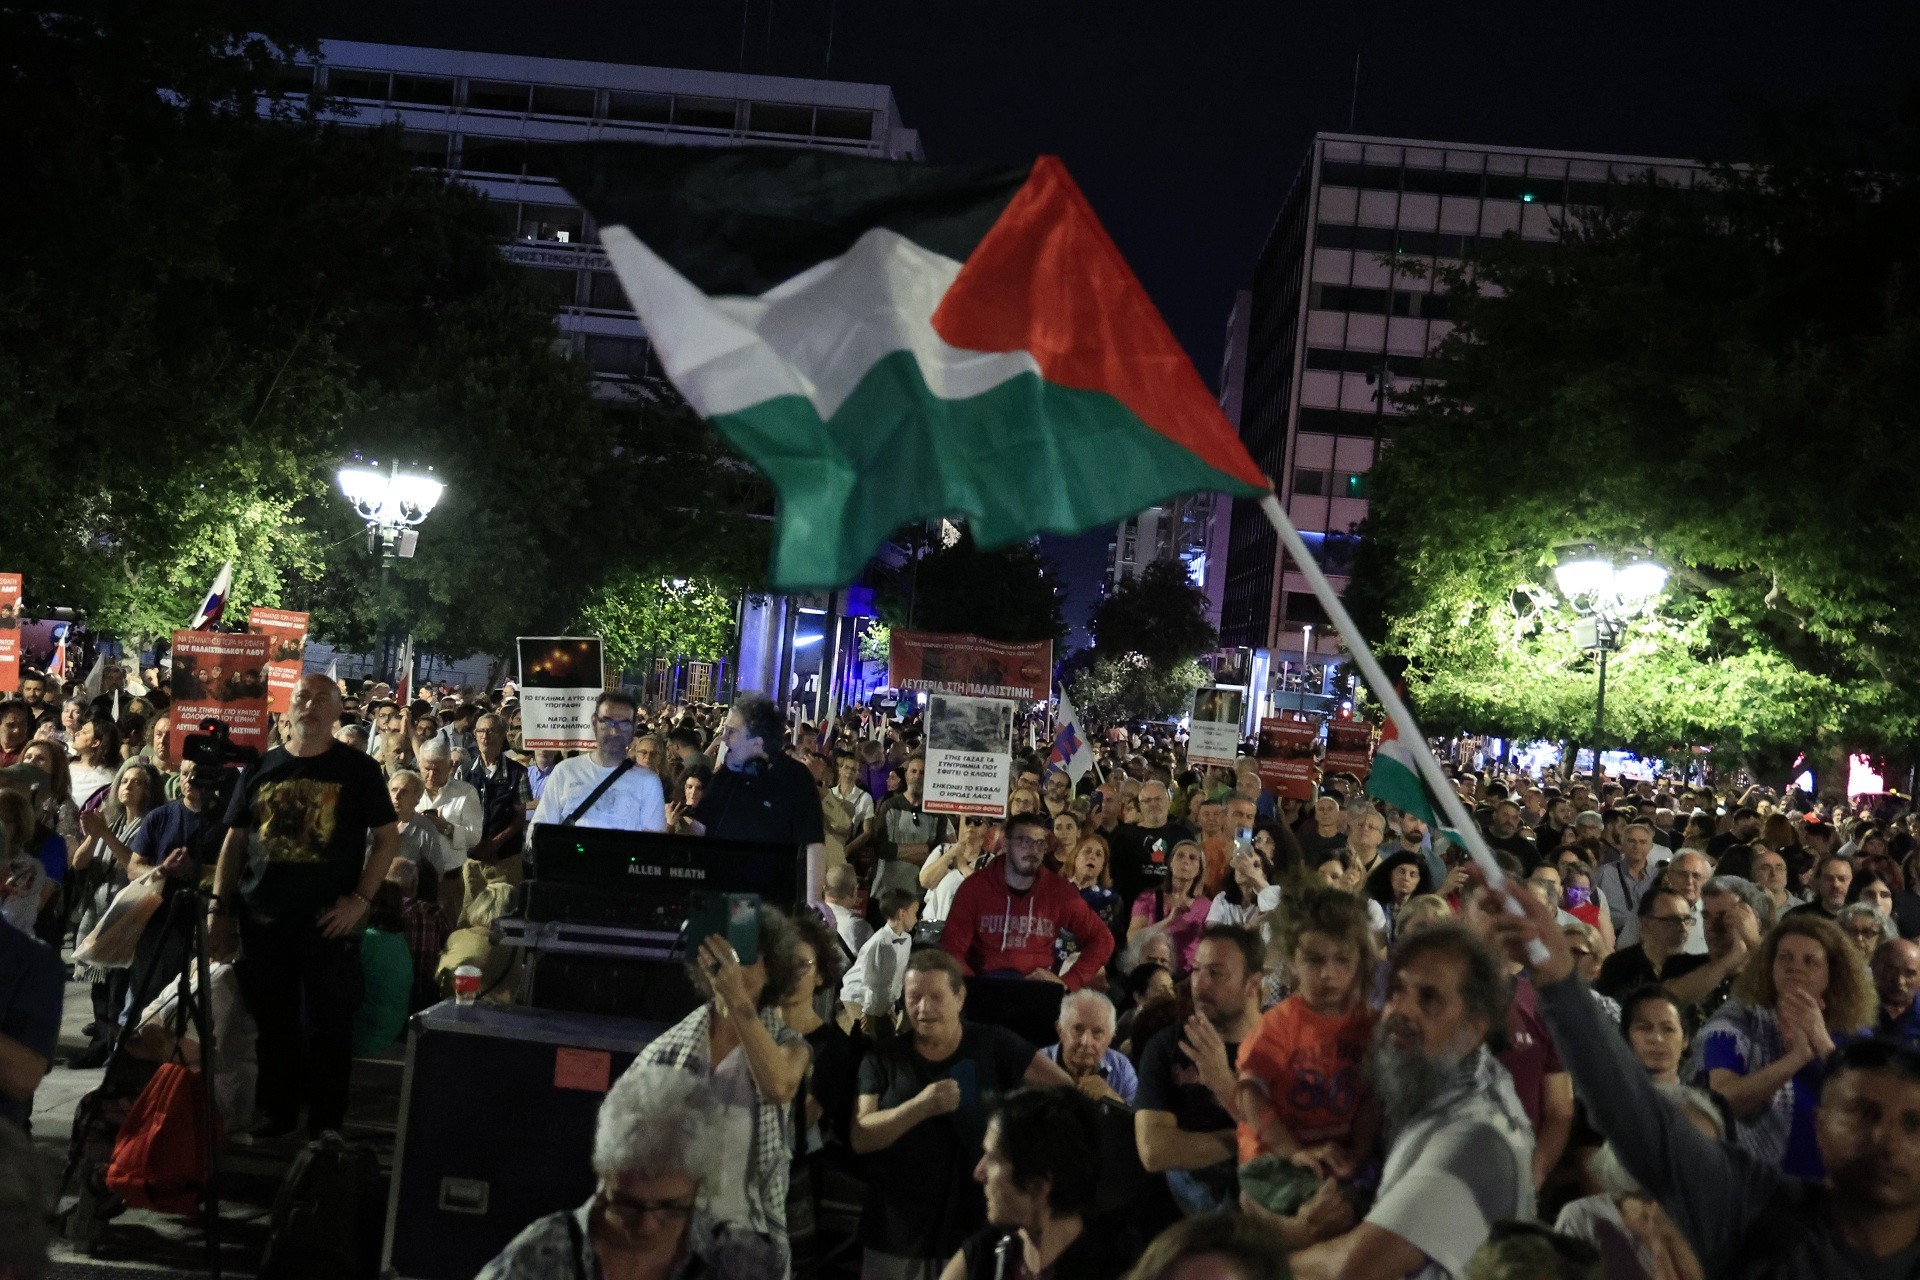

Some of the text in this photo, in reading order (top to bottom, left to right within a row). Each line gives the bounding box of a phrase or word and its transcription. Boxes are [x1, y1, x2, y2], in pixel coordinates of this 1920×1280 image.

[177, 635, 187, 643] ΝΑ
[177, 644, 190, 652] ΤΟΥ
[245, 648, 265, 656] ΛΑΟΥ
[900, 678, 1034, 699] ΛΕΥΤΕΡΙΑ ΣΤΗ ΠΑΛΑΙΣΤΙΝΗ!
[176, 723, 261, 735] ΛΕΥΤΕΡΙ ΛΑΙΣΤΙΝΗ!
[938, 761, 980, 769] ΣΥΝΤΡΙΜΜΙΑ
[932, 782, 963, 791] ΣΗΚΩΝΕΙ
[628, 864, 706, 880] ALLEN HEATH
